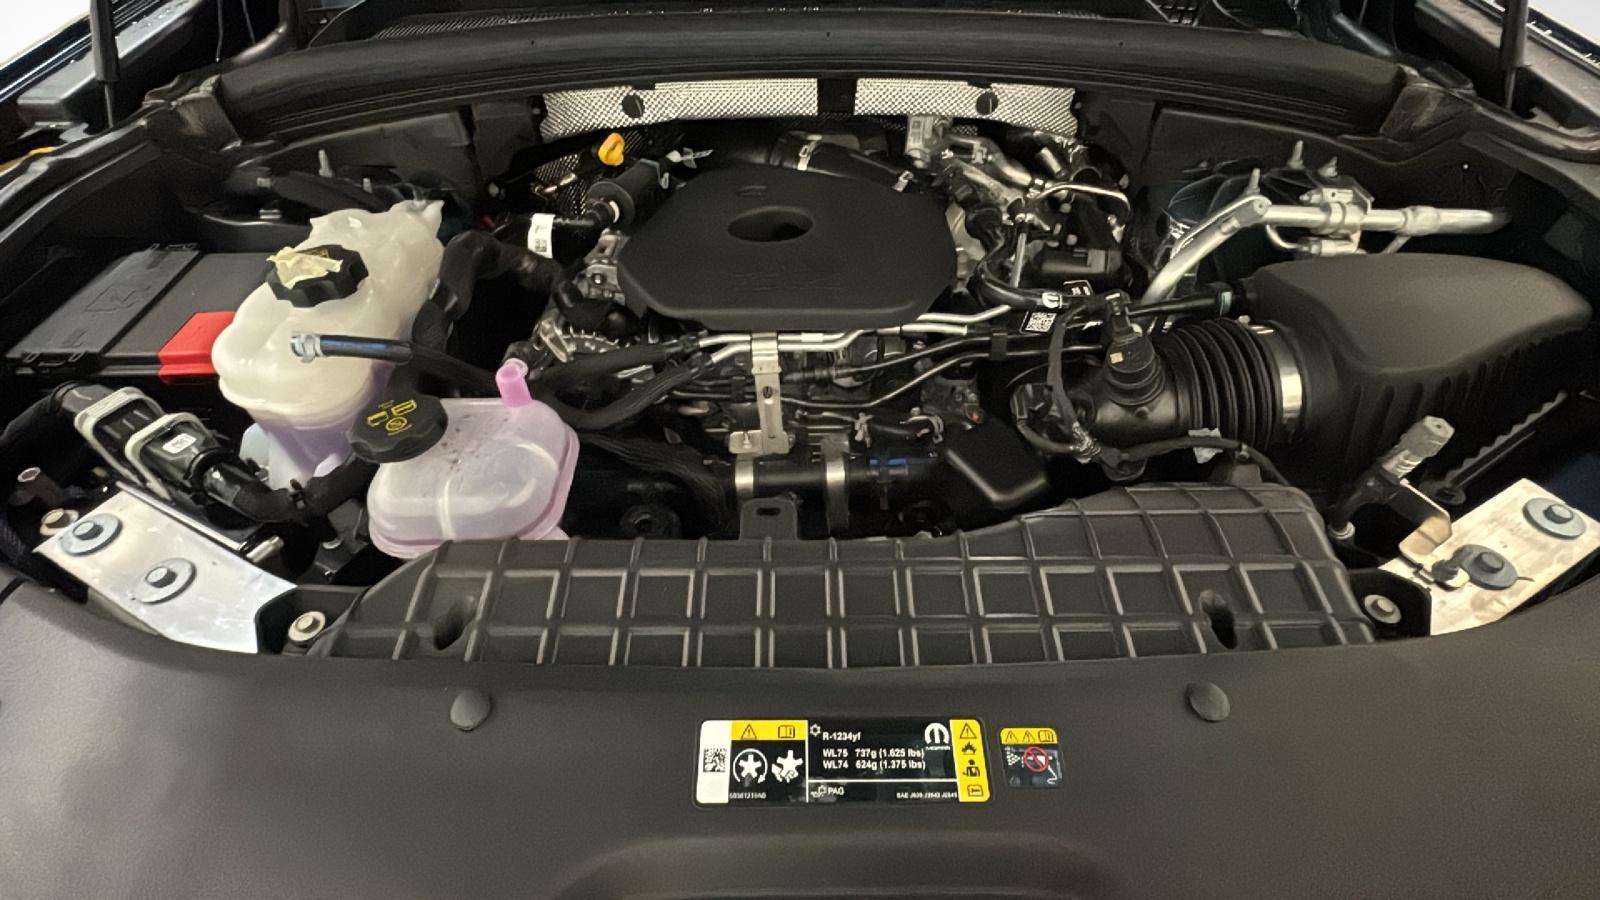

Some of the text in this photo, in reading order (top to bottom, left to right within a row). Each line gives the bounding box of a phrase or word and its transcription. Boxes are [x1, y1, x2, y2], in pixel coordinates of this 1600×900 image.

[822, 731, 861, 742] R-1234yf
[822, 748, 848, 758] WL75
[854, 748, 877, 759] 737g
[878, 748, 906, 759] (1.625
[907, 748, 925, 759] lbs)
[822, 759, 926, 770] WL74 624g (1.375 lbs)
[828, 786, 845, 796] PAG
